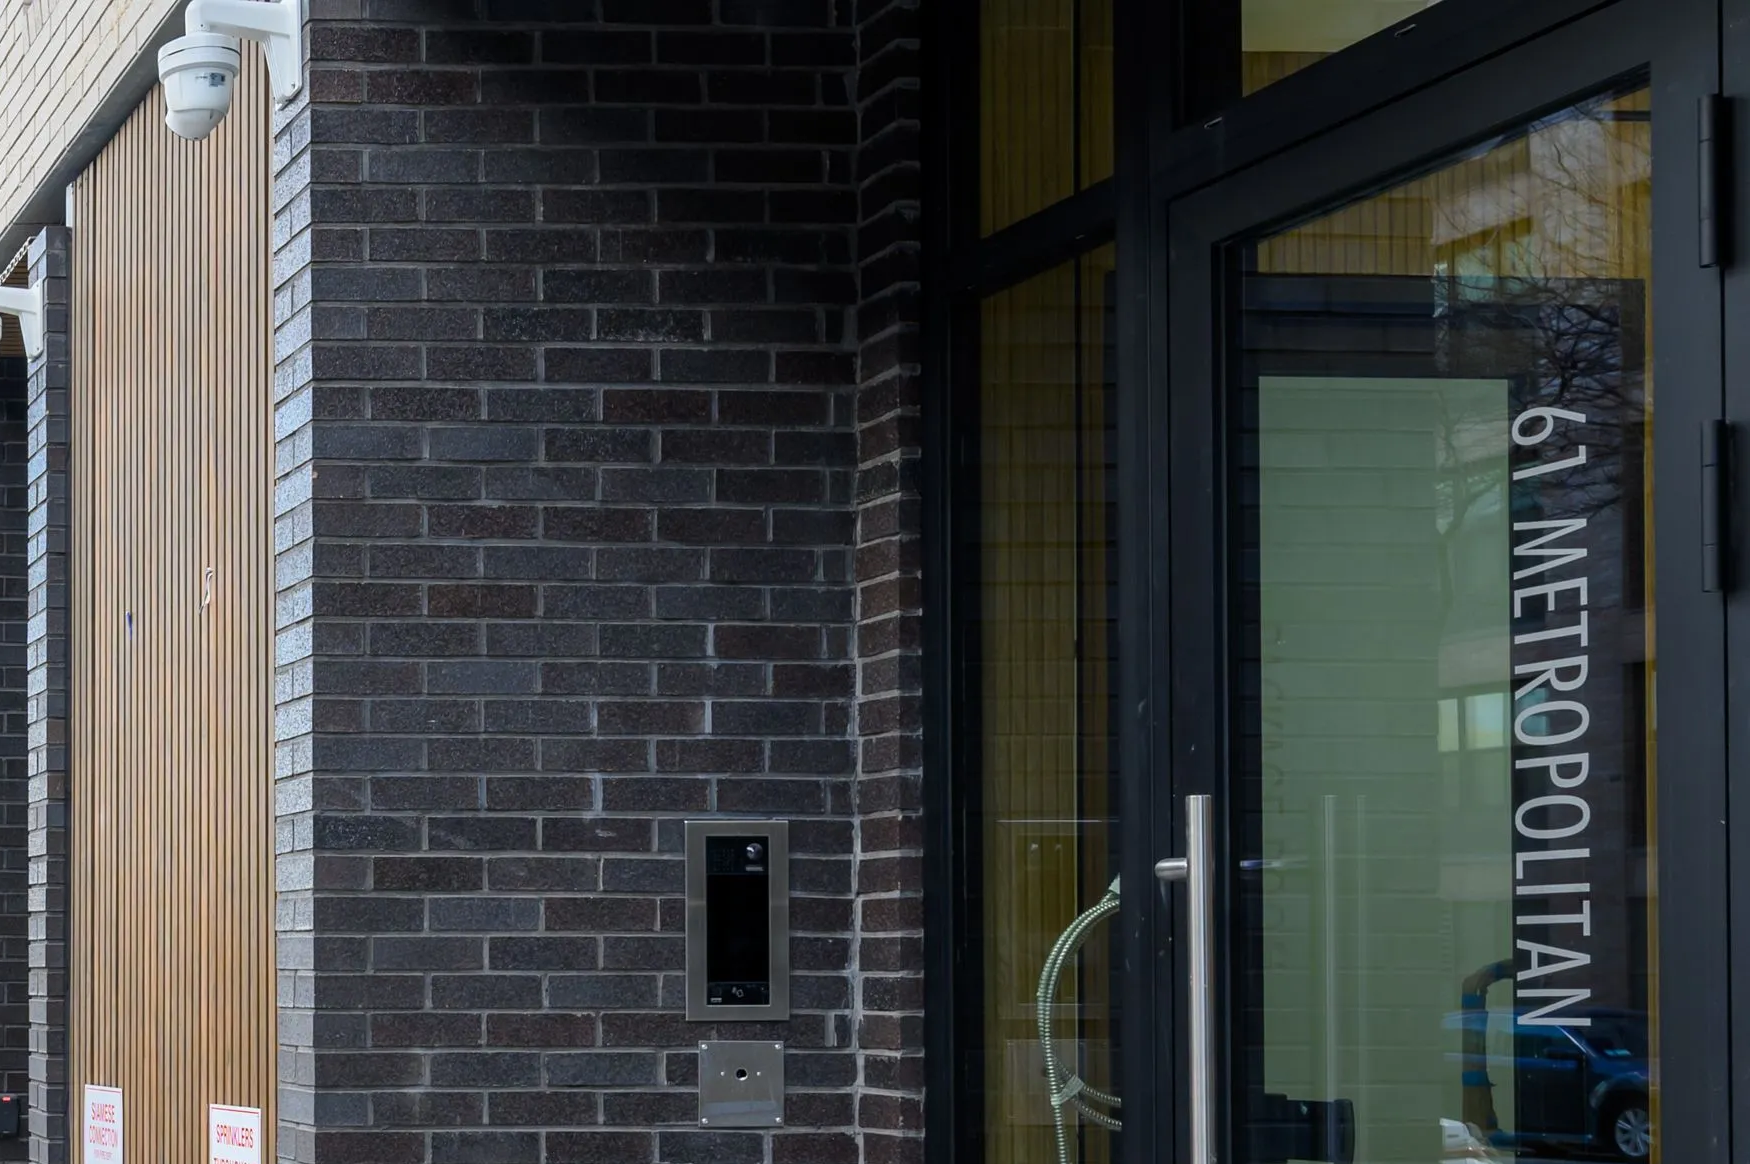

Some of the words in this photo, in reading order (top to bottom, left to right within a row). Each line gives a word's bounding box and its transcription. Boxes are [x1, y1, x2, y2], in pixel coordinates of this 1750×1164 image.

[1511, 404, 1589, 481] 61
[1512, 517, 1593, 1027] METROPOLITAN
[91, 1102, 115, 1123] SIAMESE
[89, 1125, 118, 1148] CONNECTION
[216, 1124, 254, 1149] SPRINKLERS
